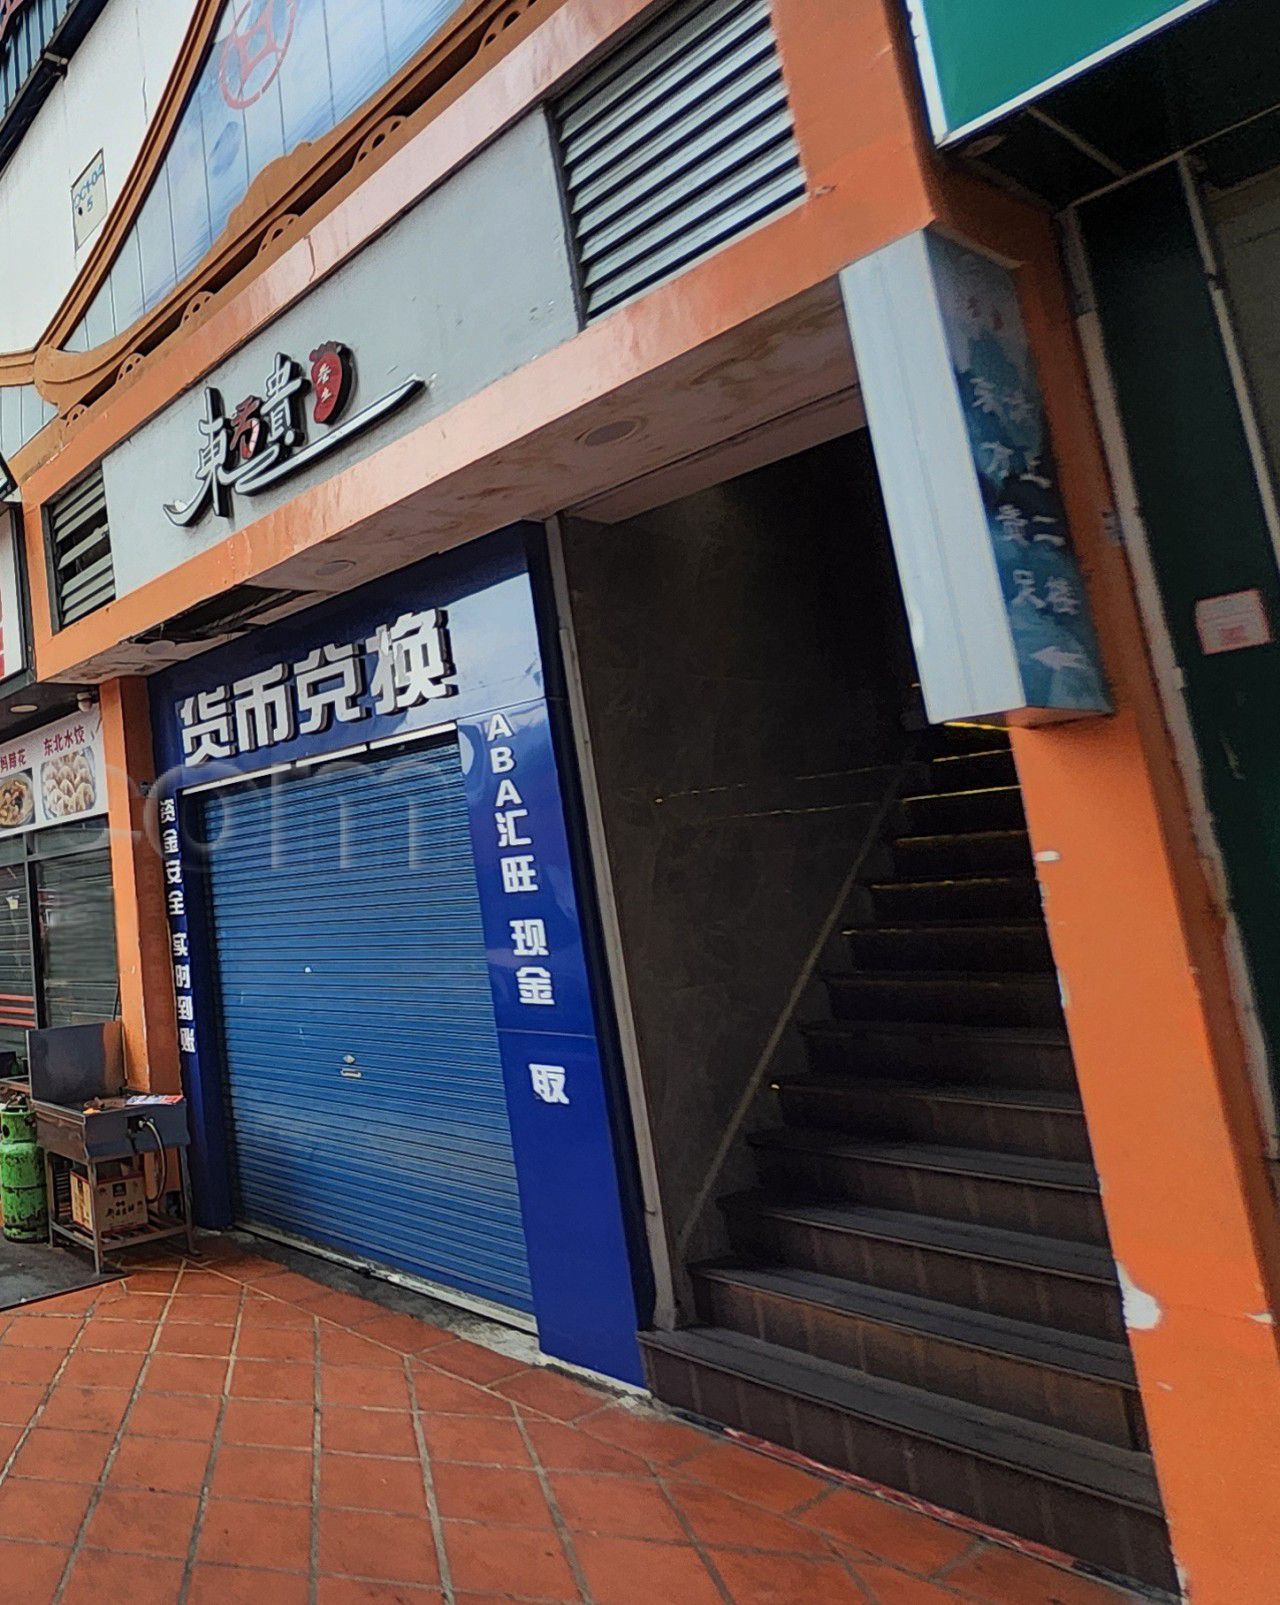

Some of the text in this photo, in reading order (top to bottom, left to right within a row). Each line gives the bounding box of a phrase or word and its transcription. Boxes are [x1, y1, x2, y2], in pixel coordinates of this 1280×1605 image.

[43, 725, 86, 757] 东北水饺
[509, 918, 556, 1006] 现金
[528, 1063, 571, 1105] 取
